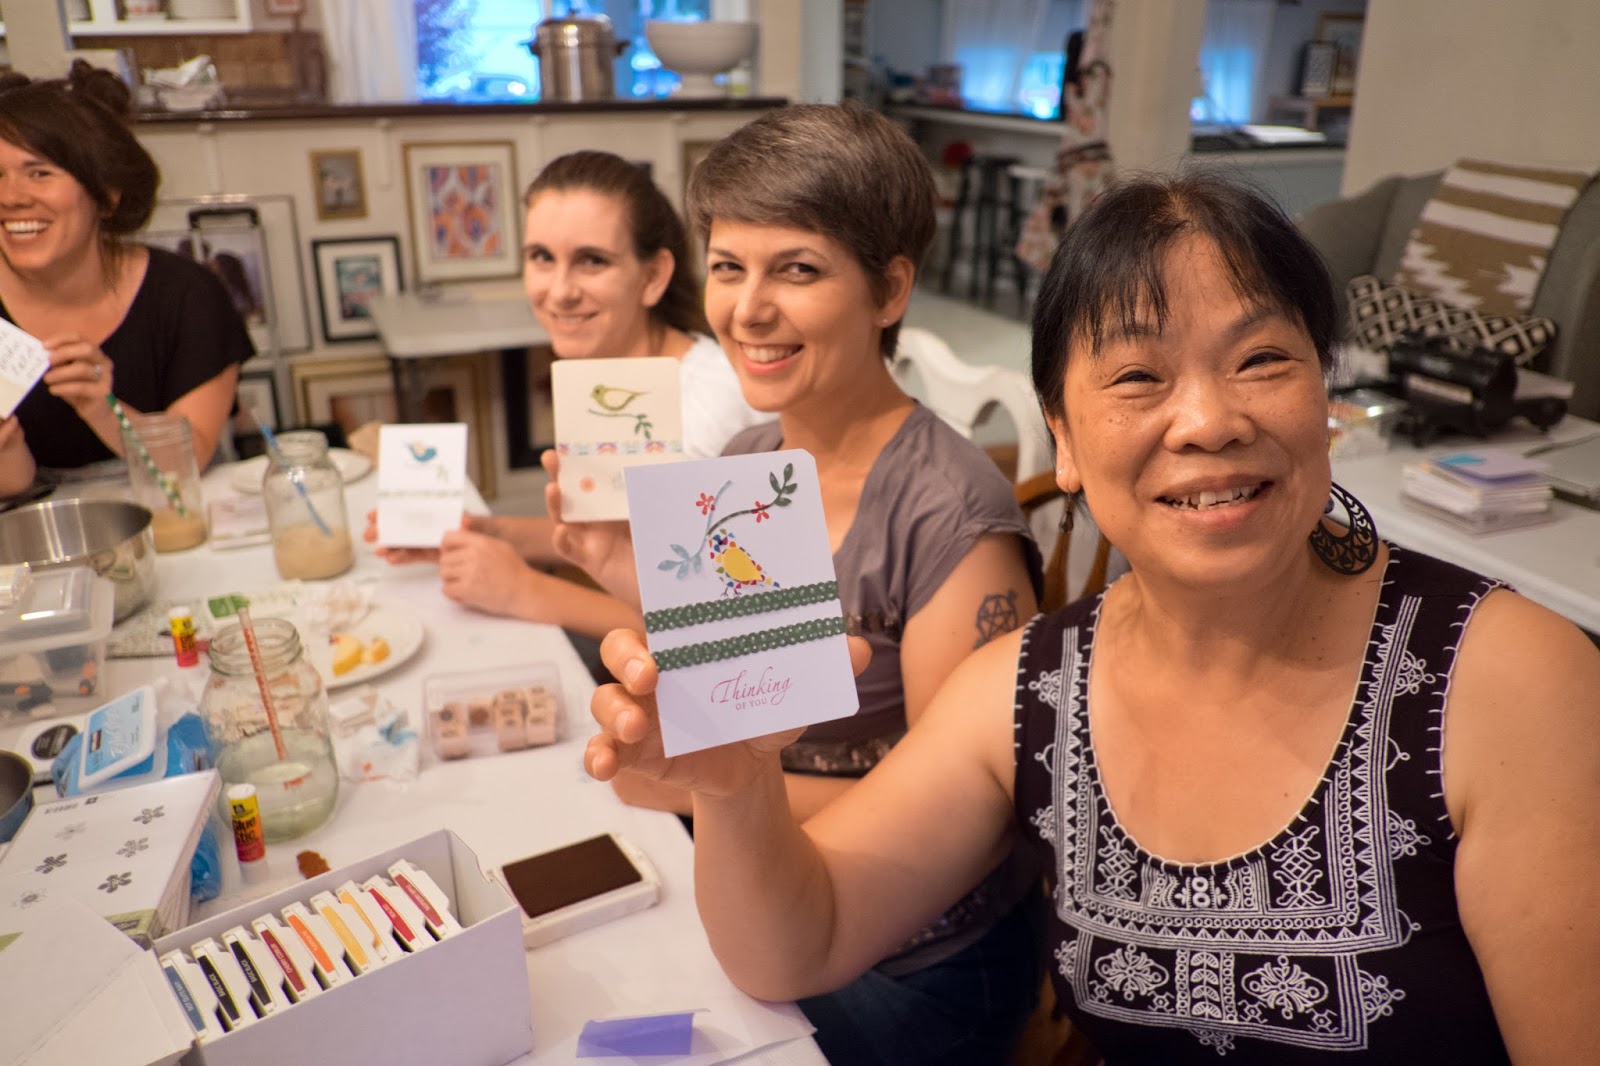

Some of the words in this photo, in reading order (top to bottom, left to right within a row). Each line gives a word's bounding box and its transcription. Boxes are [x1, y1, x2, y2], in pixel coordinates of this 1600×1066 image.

[710, 666, 792, 705] Thinking
[735, 702, 746, 710] OF
[749, 698, 767, 707] YOU
[208, 972, 219, 986] BLACK
[214, 983, 225, 997] BASIC
